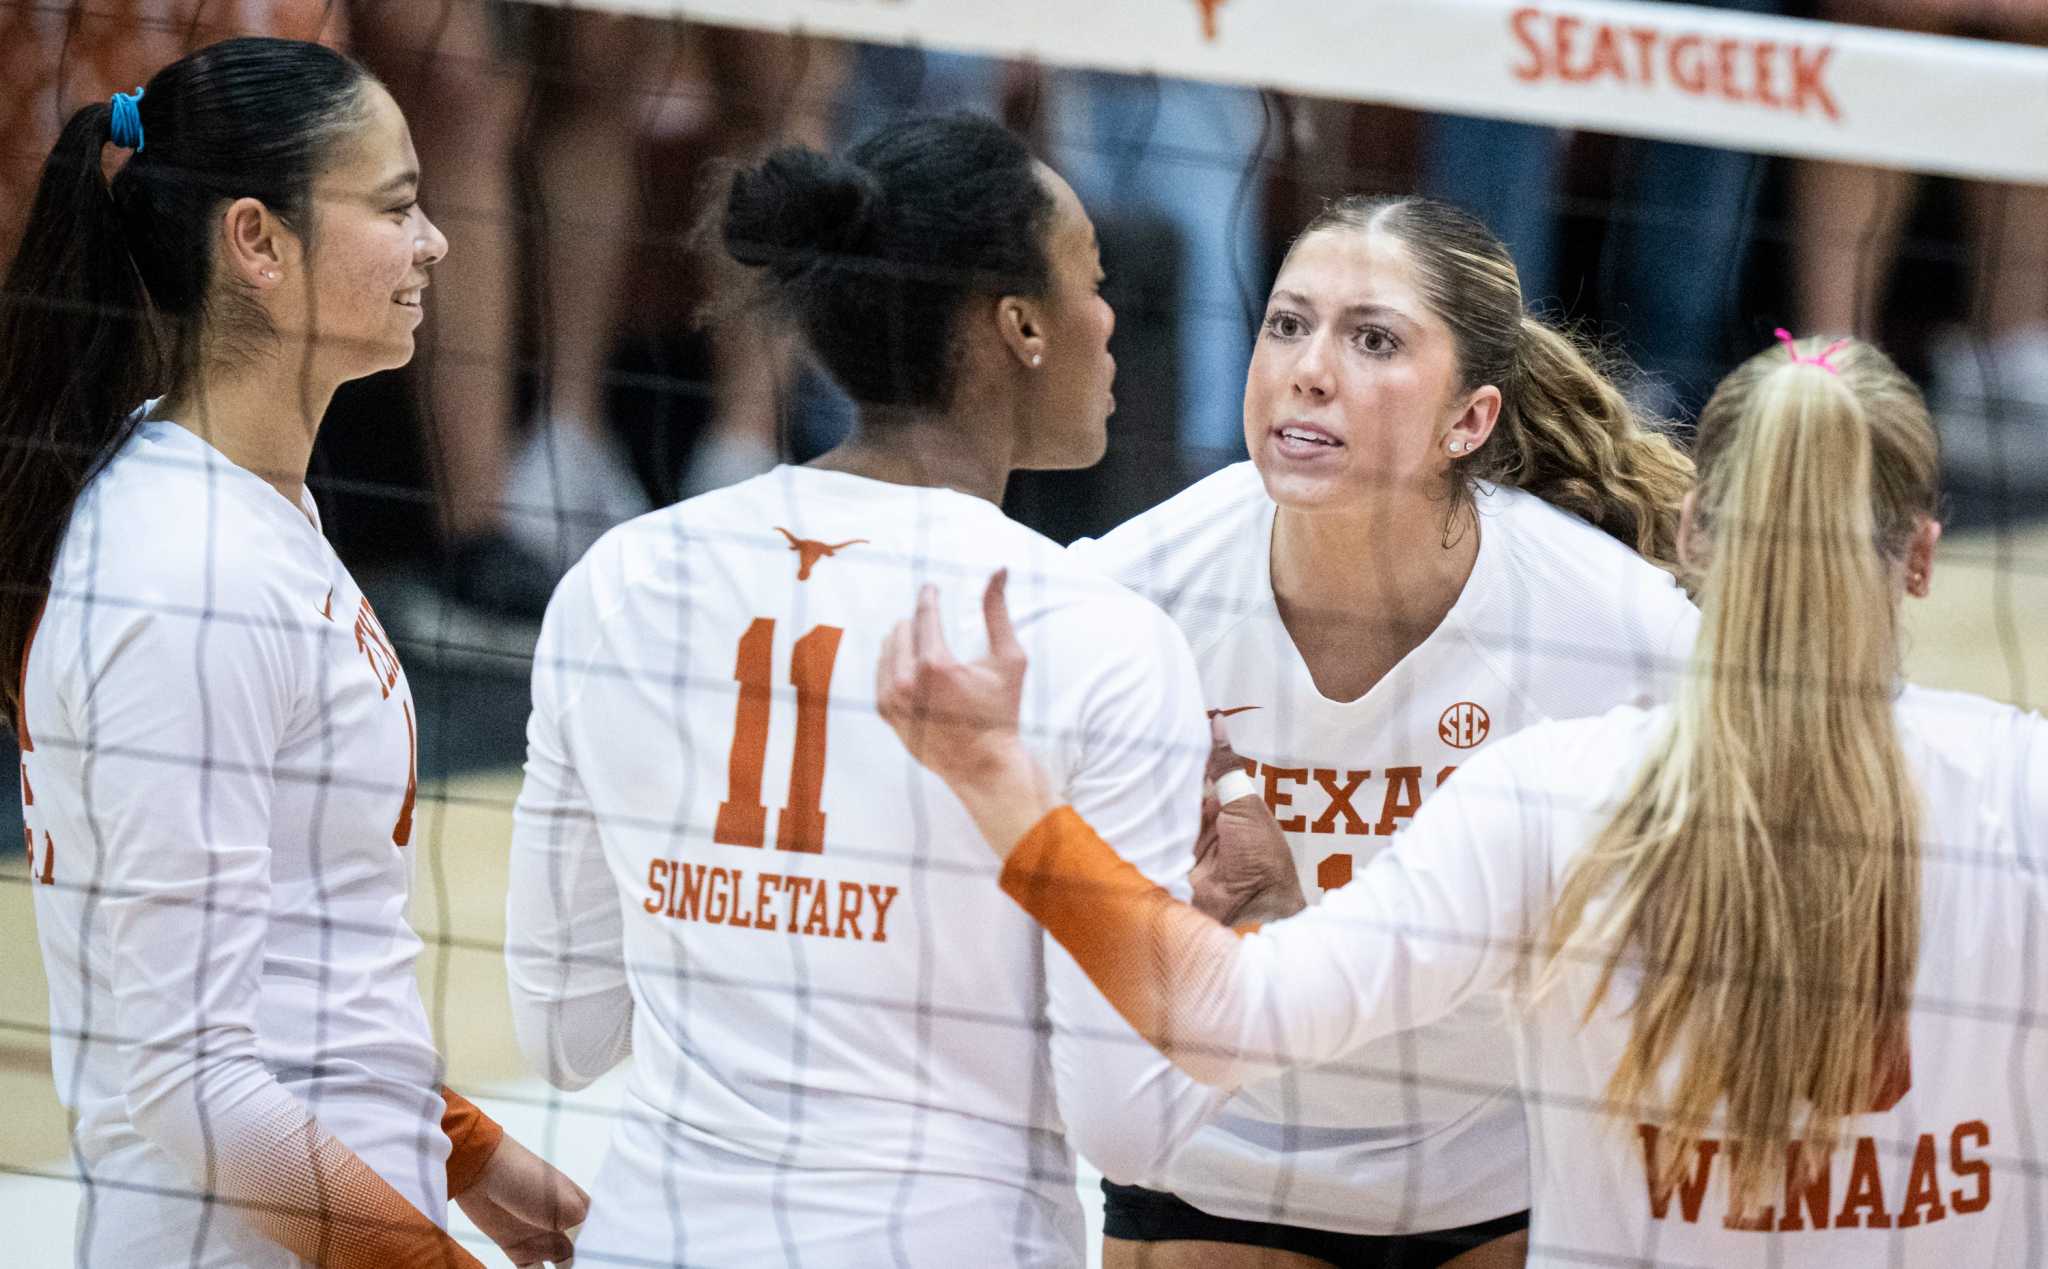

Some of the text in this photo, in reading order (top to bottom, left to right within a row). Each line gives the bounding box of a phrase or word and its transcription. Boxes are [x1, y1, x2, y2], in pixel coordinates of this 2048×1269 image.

[1509, 7, 1842, 122] SEATGEEK
[713, 617, 844, 854] 11
[1440, 702, 1488, 748] SEC
[1243, 757, 1459, 836] EXA
[643, 857, 899, 943] SINGLETARY
